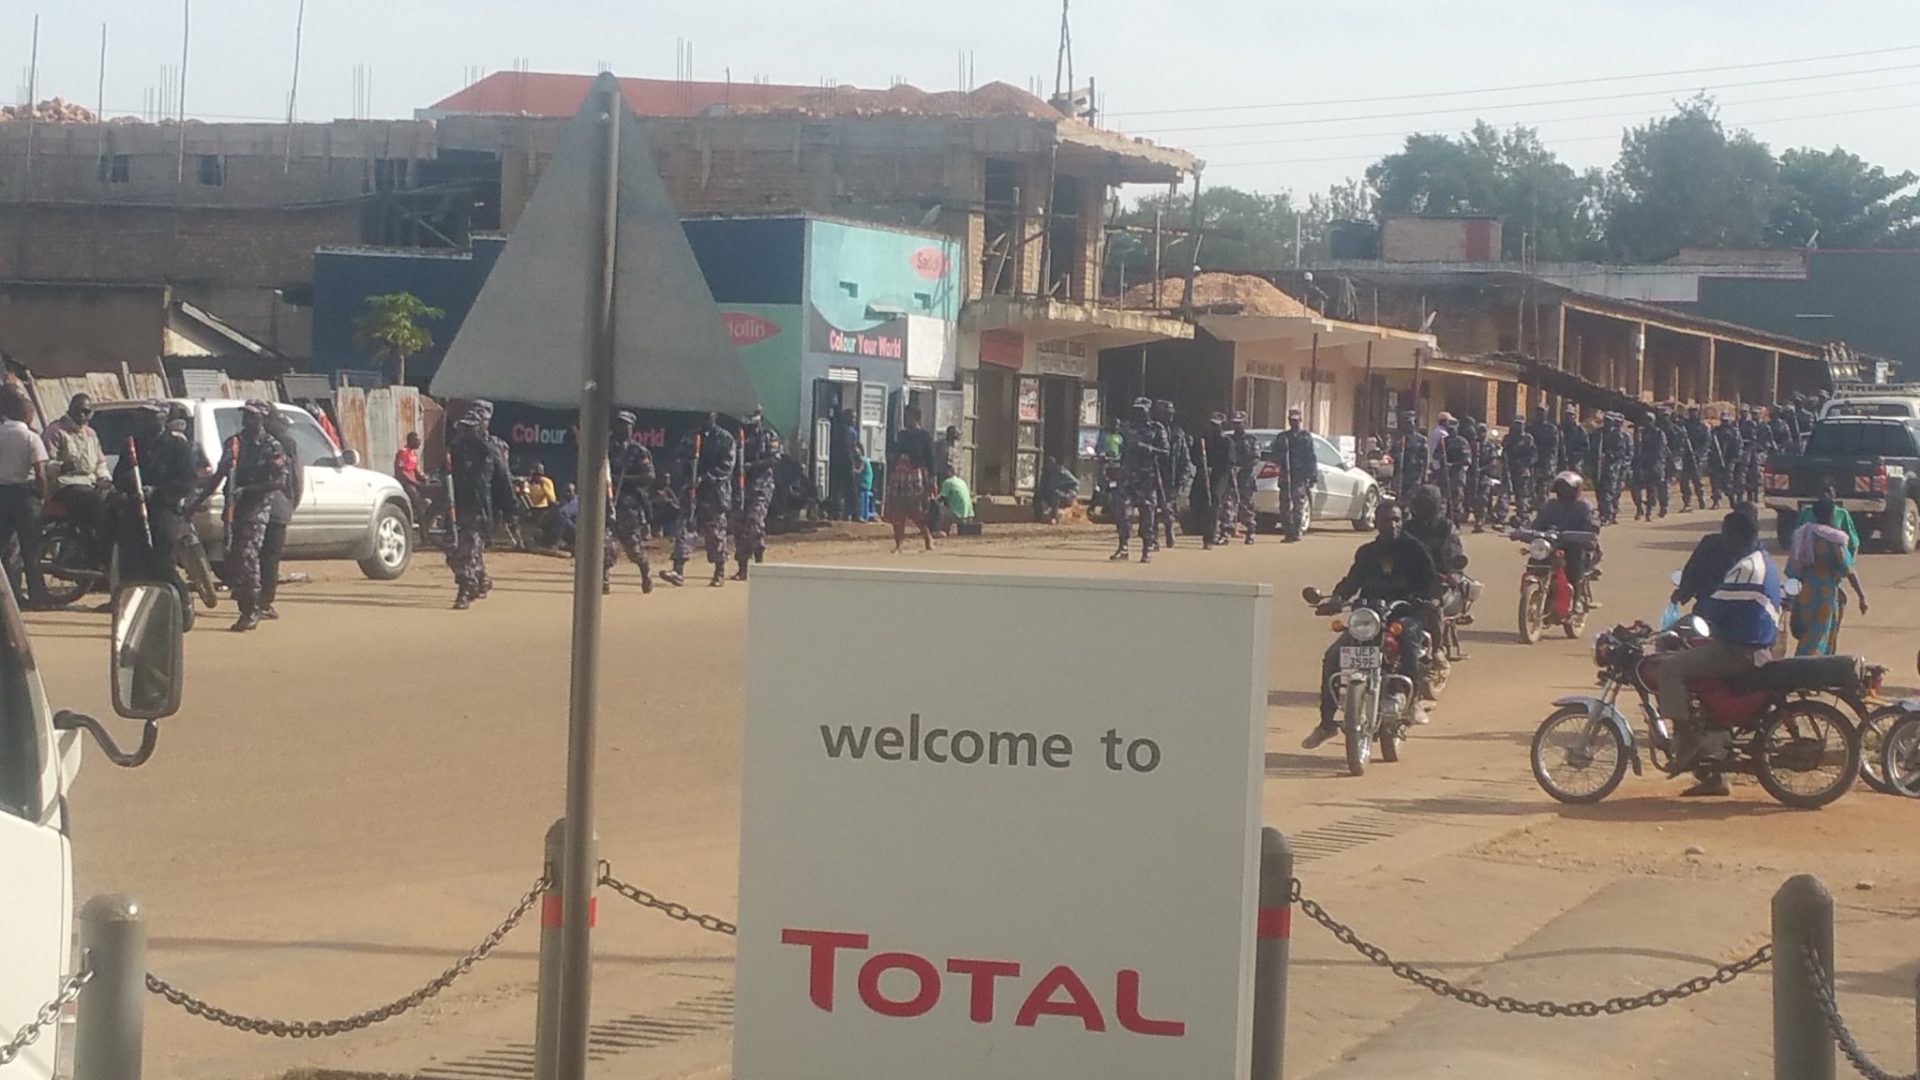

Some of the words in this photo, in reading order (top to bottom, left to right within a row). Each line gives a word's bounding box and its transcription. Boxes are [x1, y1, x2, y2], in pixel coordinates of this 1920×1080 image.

[829, 329, 856, 353] Colour
[858, 334, 877, 355] Your
[878, 336, 901, 358] World
[512, 424, 567, 443] Colour
[630, 427, 665, 446] orld
[820, 713, 1072, 768] welcome
[1100, 728, 1161, 773] to
[781, 928, 1185, 1036] TOTAL
